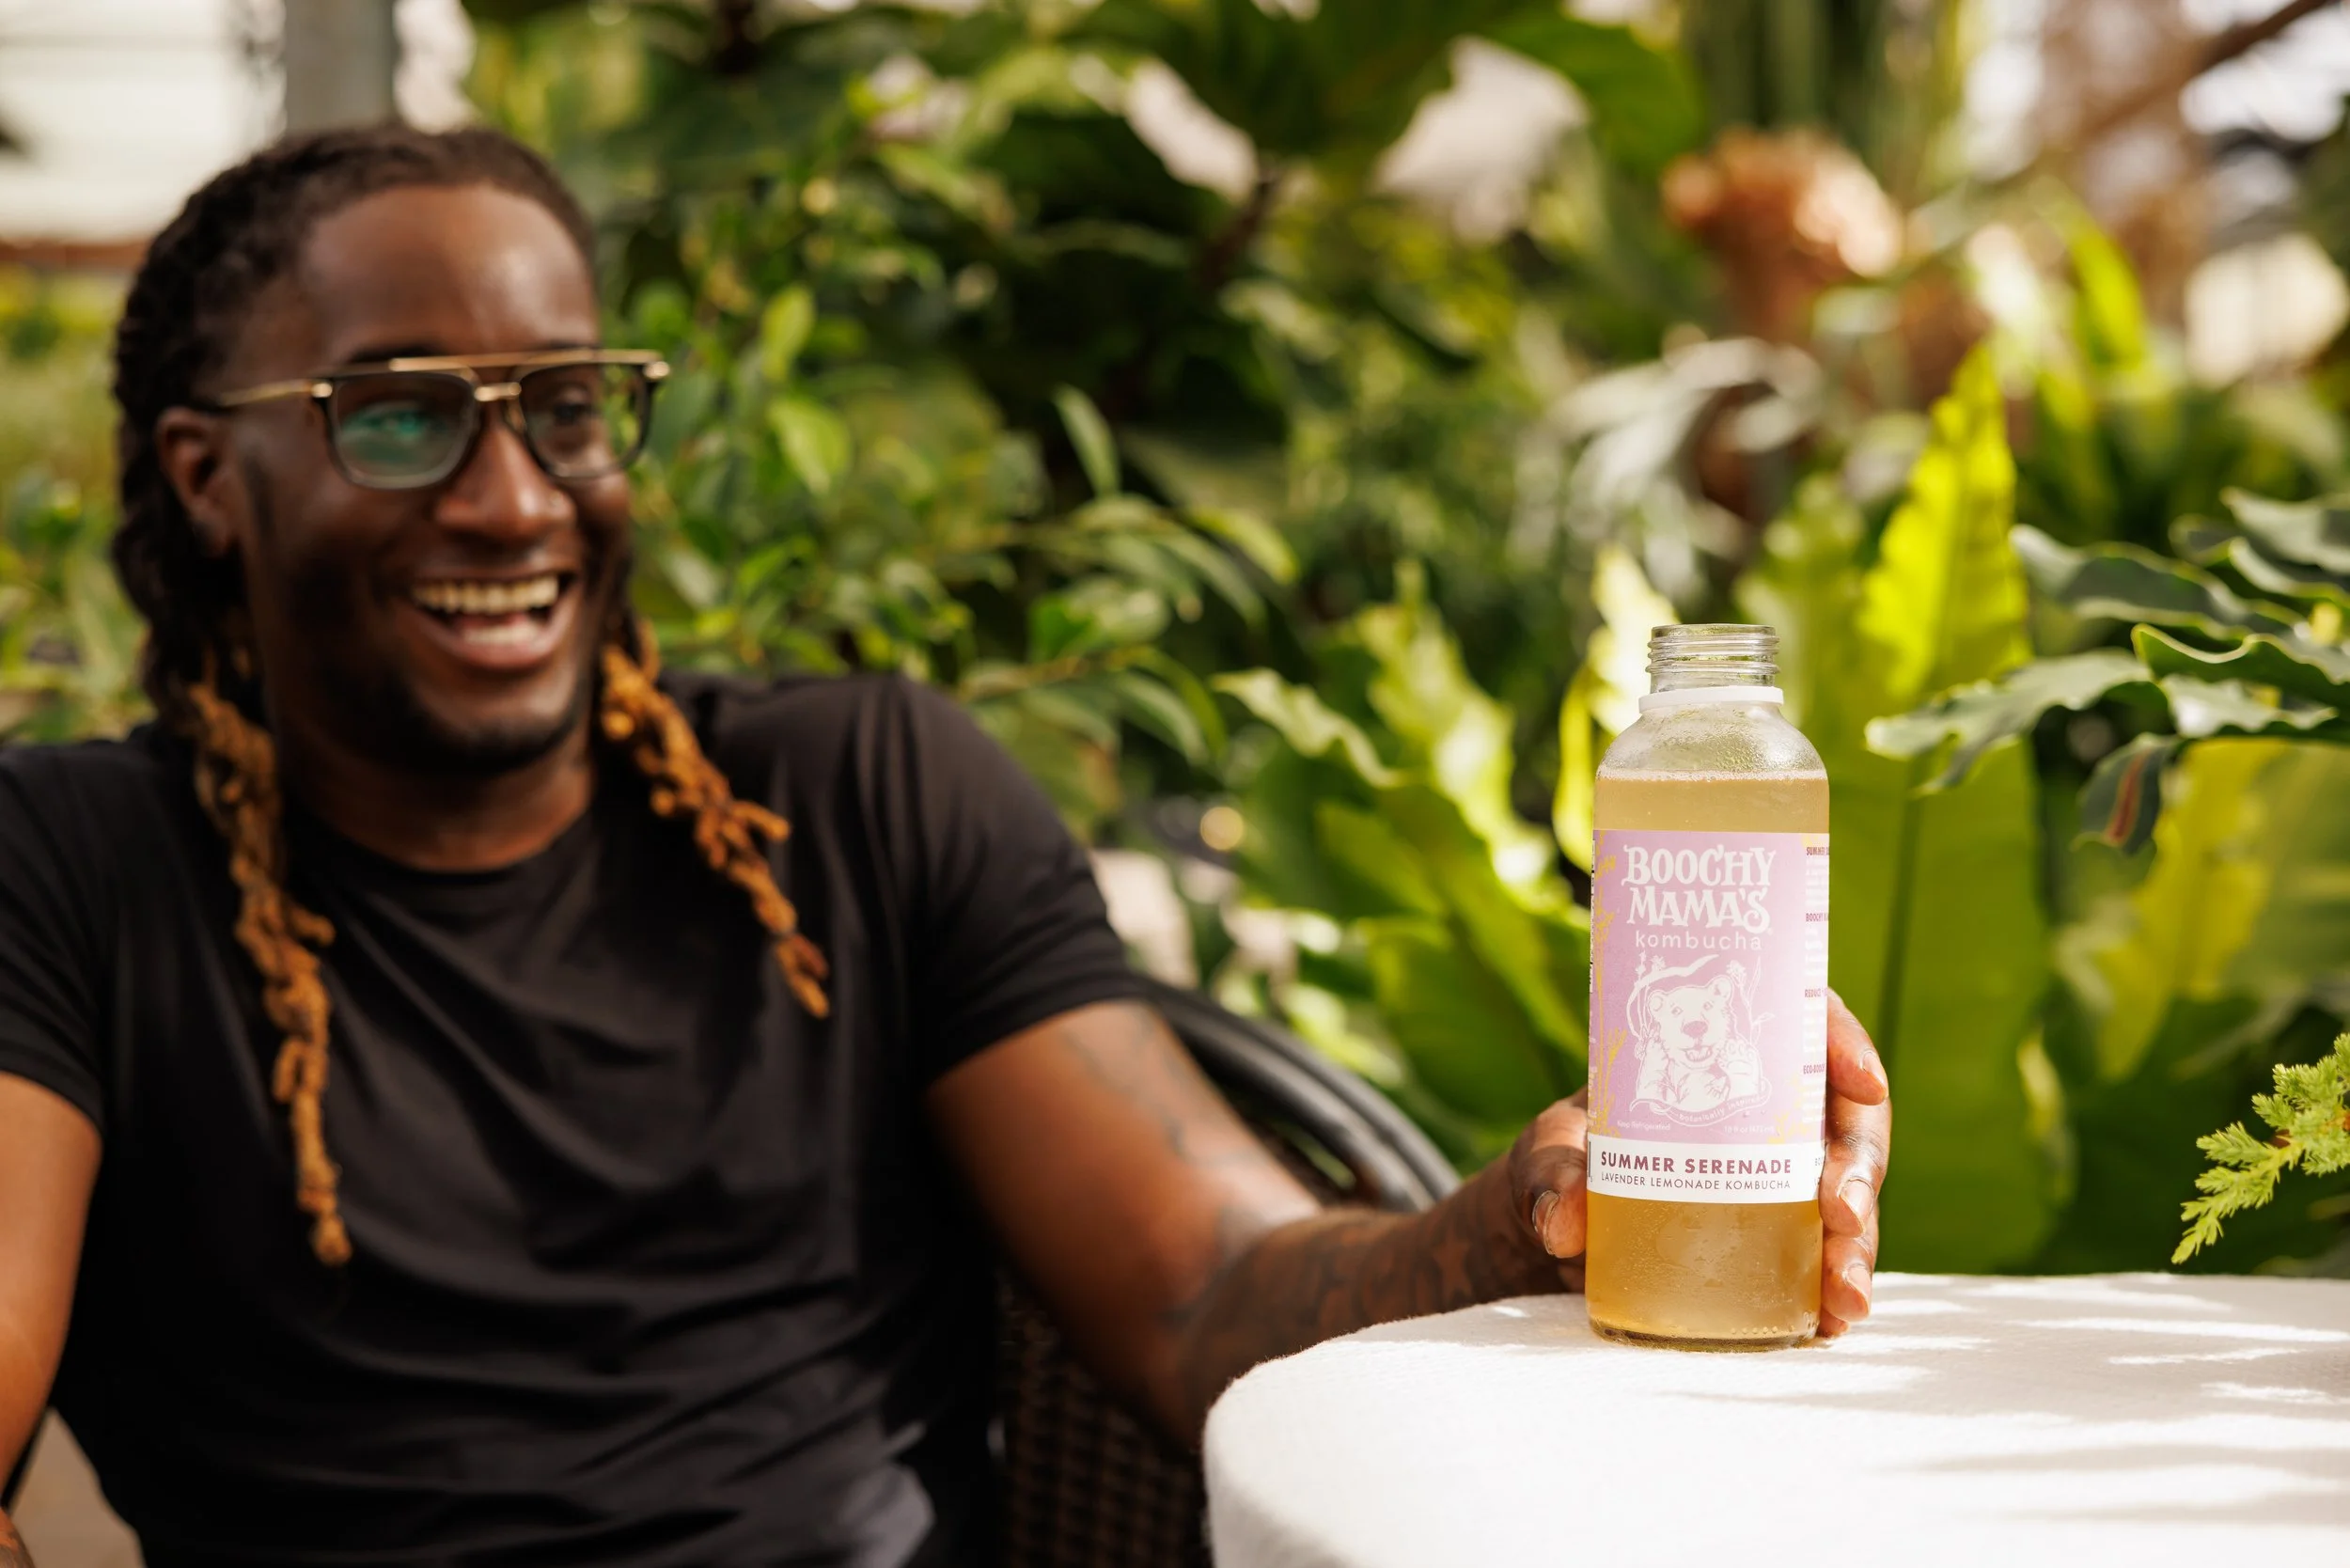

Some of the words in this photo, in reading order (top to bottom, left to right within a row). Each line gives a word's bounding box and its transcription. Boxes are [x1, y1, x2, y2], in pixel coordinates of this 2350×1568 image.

[1622, 844, 1776, 886] BOOCHY
[1626, 886, 1771, 934] MAMA'S
[1636, 930, 1762, 950] kombucha
[1679, 1107, 1725, 1122] botanically
[1601, 1151, 1675, 1172] SUMMER
[1684, 1158, 1792, 1174] SERENADE
[1601, 1172, 1645, 1186] LAVENDER
[1651, 1177, 1720, 1190] LEMONADE
[1725, 1179, 1791, 1190] KOMBUCHA
